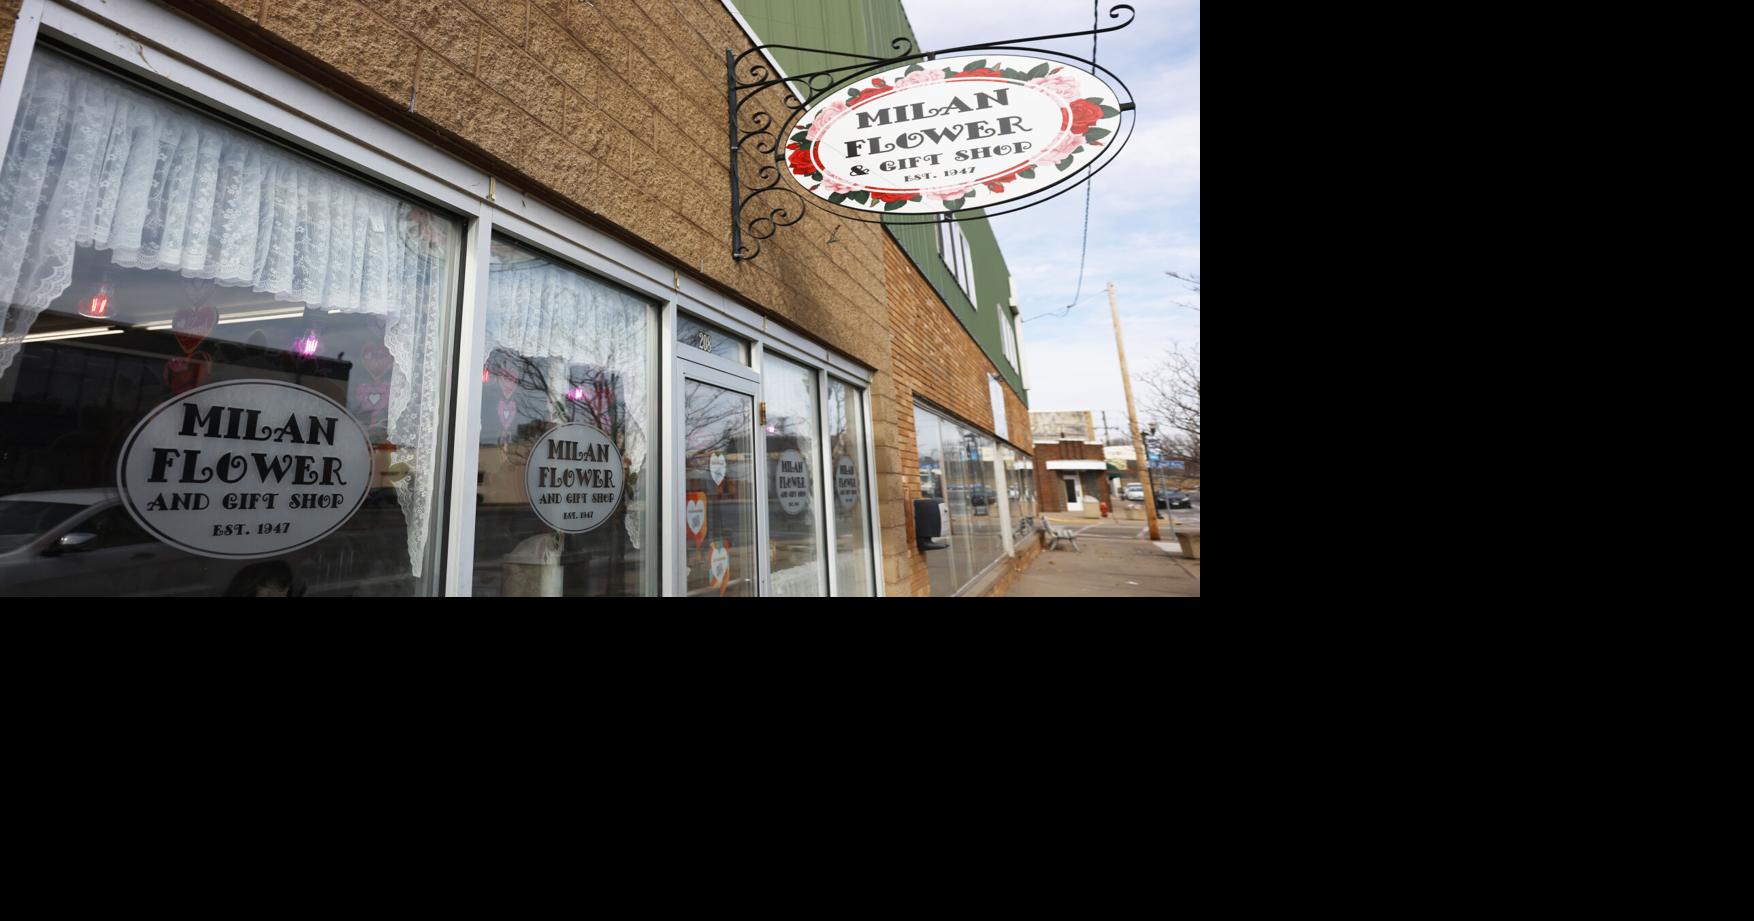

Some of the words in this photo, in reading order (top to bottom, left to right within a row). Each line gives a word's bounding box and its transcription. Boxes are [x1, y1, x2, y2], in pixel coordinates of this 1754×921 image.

[855, 88, 1010, 129] MILAN
[844, 115, 1033, 158] FLOWER
[849, 164, 870, 177] &
[879, 153, 943, 172] GIFT
[954, 141, 1033, 162] SHOP
[904, 172, 937, 183] EST.
[944, 166, 977, 177] 1947
[699, 332, 711, 353] 208
[178, 402, 338, 446] MILAN
[547, 439, 609, 462] MILAN
[147, 447, 347, 486] FLOWER
[538, 466, 615, 488] FLOWER
[781, 460, 803, 473] MILAN
[147, 492, 210, 511] AND
[222, 493, 279, 510] GIFT
[288, 493, 344, 509] SHOP
[539, 493, 562, 504] AND
[566, 493, 588, 504] GIFT
[591, 492, 614, 503] SHOP
[563, 512, 577, 520] EST.
[212, 523, 250, 537] EST.
[256, 522, 290, 535] 1947
